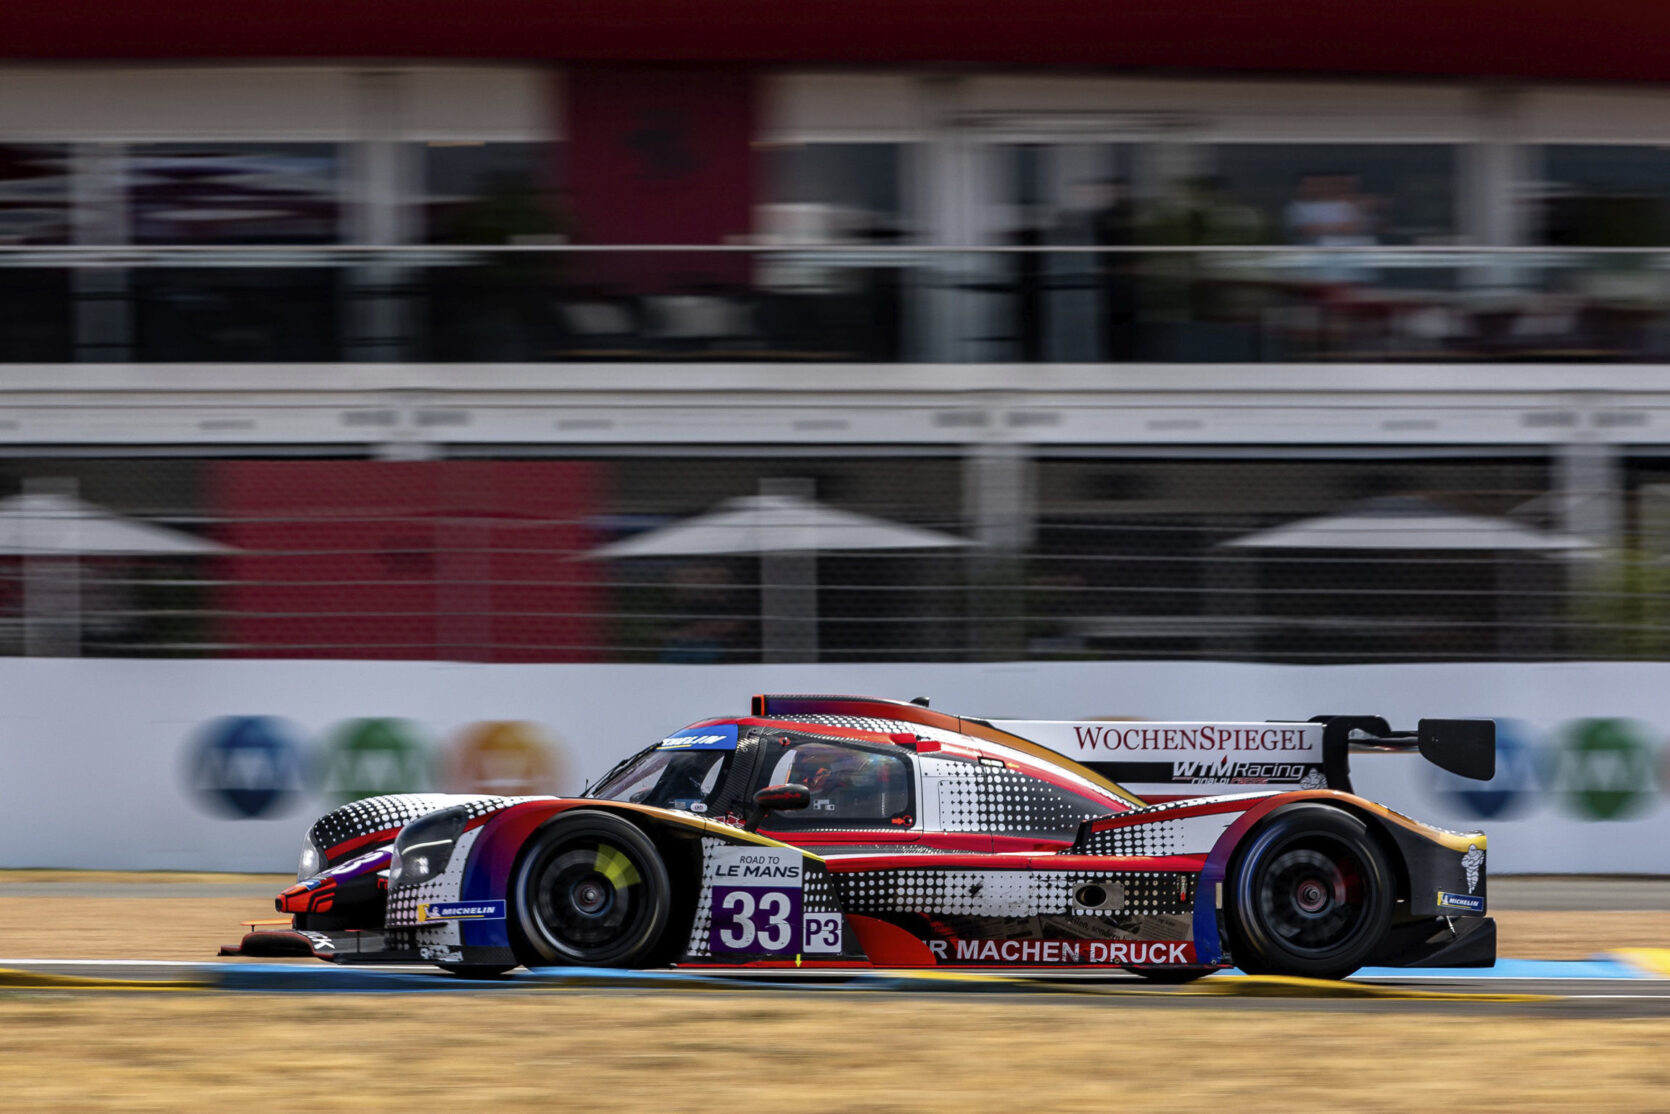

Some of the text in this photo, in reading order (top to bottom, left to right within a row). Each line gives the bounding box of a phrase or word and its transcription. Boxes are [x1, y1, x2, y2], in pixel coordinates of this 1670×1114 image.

[739, 855, 780, 864] ROAD TO
[715, 865, 800, 878] LE MANS
[1448, 897, 1479, 907] MICHELIN
[441, 906, 496, 916] MICHELIN
[719, 890, 793, 951] 33
[805, 918, 840, 947] P3
[956, 940, 1080, 963] MACHEN
[1089, 942, 1189, 964] DRUCK
